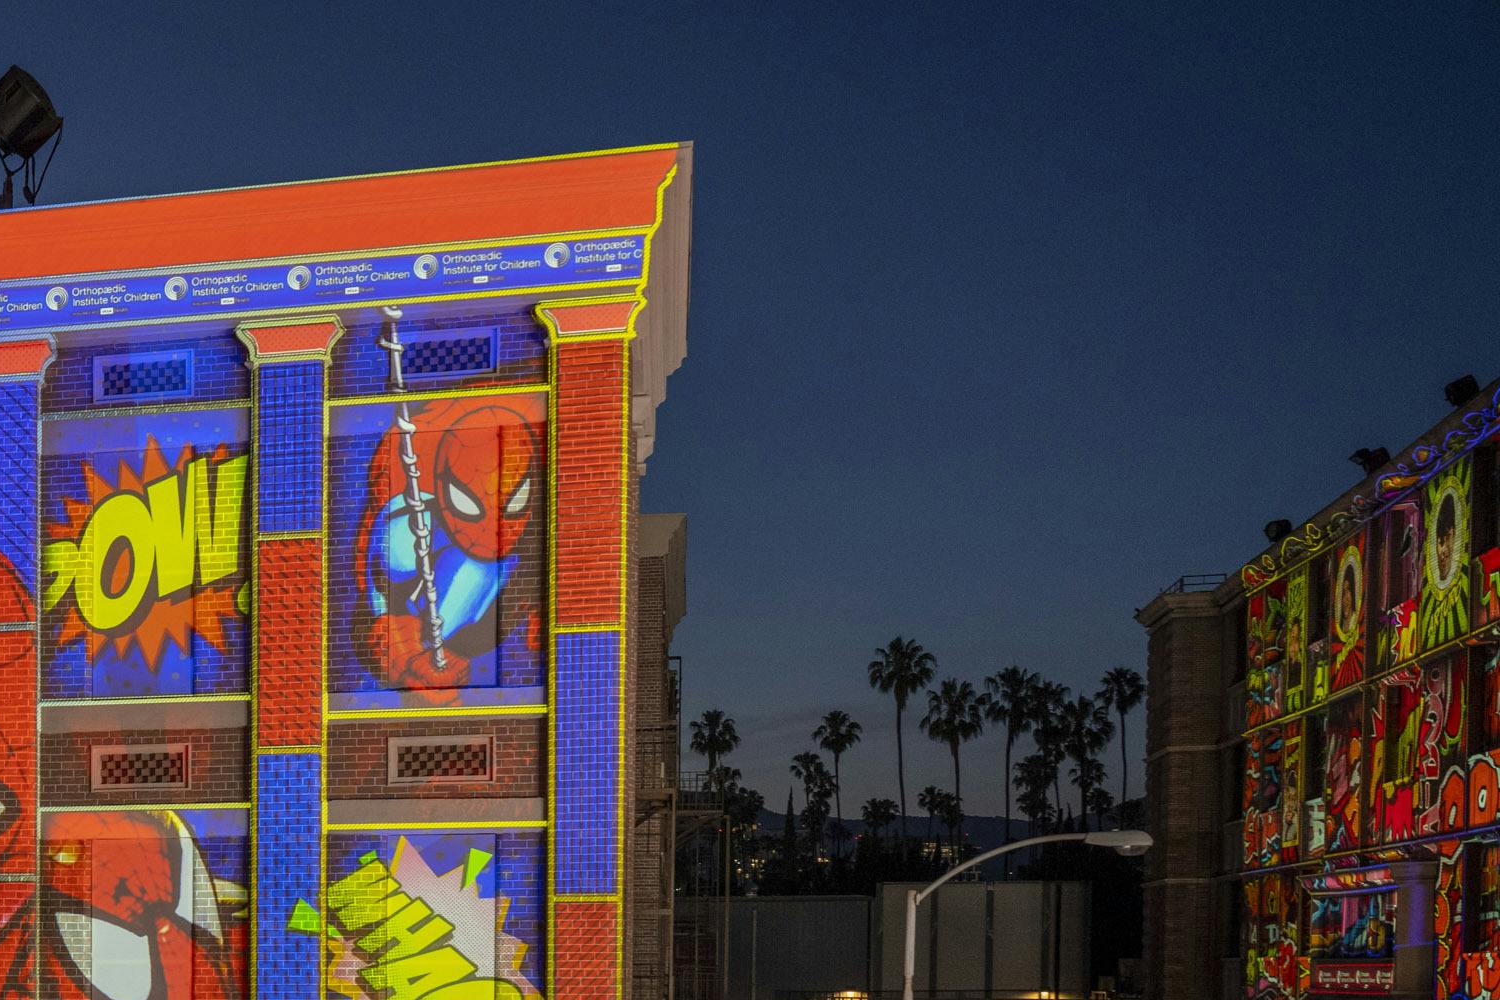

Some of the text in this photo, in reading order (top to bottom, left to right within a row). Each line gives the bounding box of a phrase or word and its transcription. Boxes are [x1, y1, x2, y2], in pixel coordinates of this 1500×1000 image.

[575, 253, 615, 264] Institute
[618, 251, 631, 260] for
[443, 259, 541, 275] Institute for Children
[315, 270, 411, 286] Institute for Children
[192, 282, 284, 297] Institute for Children
[6, 301, 43, 313] Children
[72, 292, 161, 307] Institute for Children
